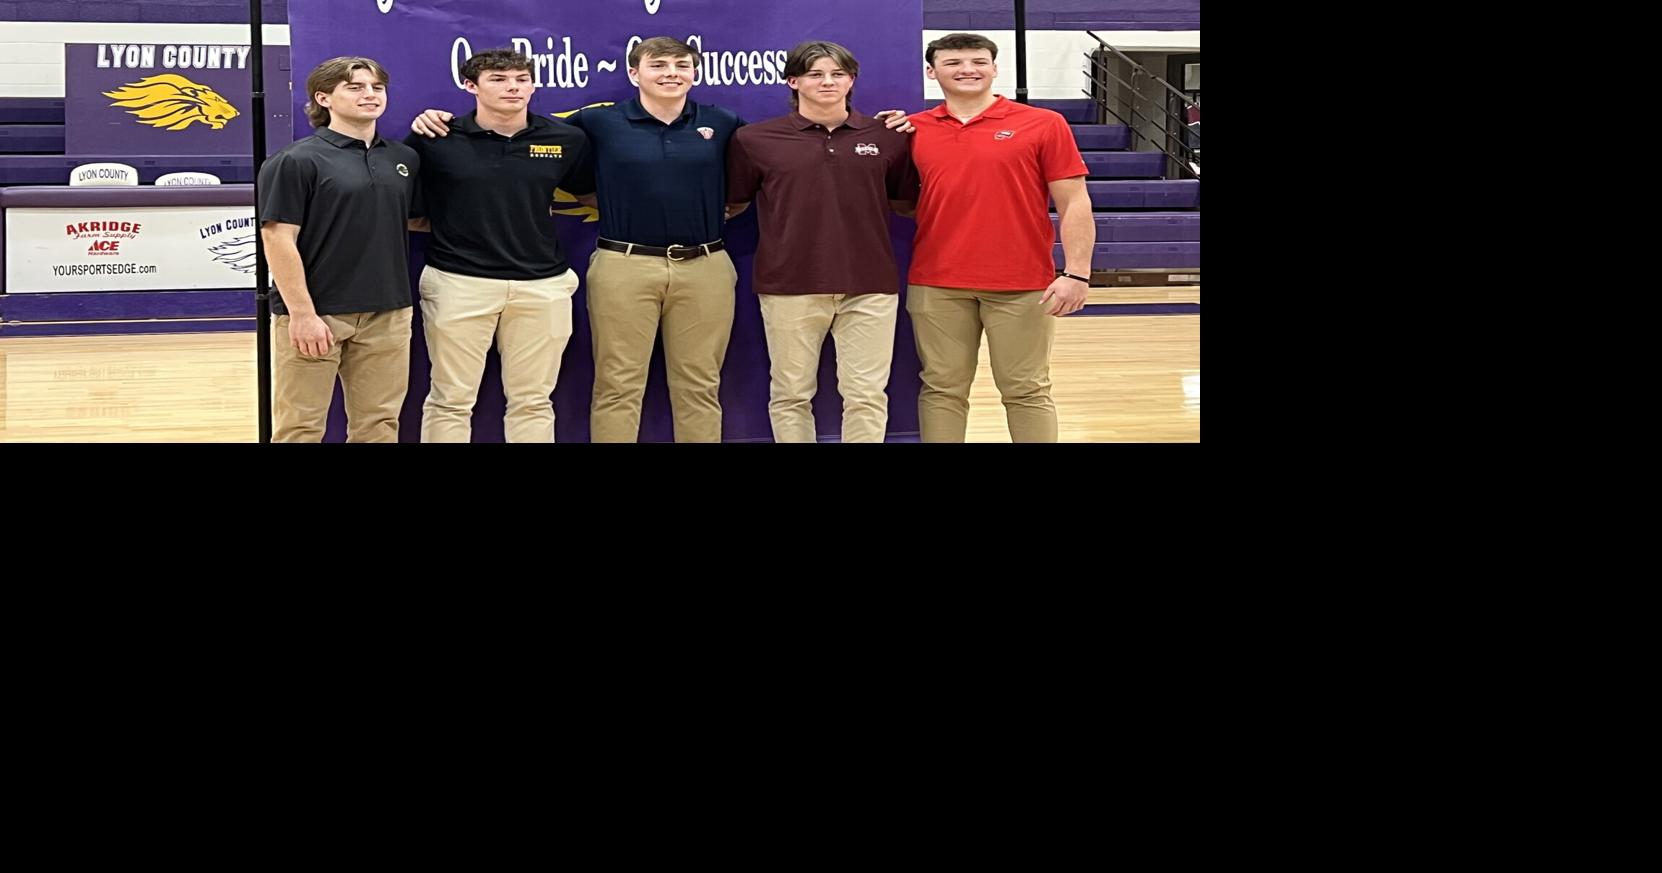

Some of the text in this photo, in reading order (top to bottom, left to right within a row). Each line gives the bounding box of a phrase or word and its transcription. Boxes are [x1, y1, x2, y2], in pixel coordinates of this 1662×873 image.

[97, 44, 251, 69] LYON COUNTY
[78, 168, 129, 181] LYON COUNTY
[66, 220, 142, 236] AKRIDGE
[199, 216, 256, 239] LYON COUNT
[102, 231, 136, 239] Supply
[88, 239, 120, 251] ACE
[52, 263, 157, 276] YOURSPORTSEDGE.com
